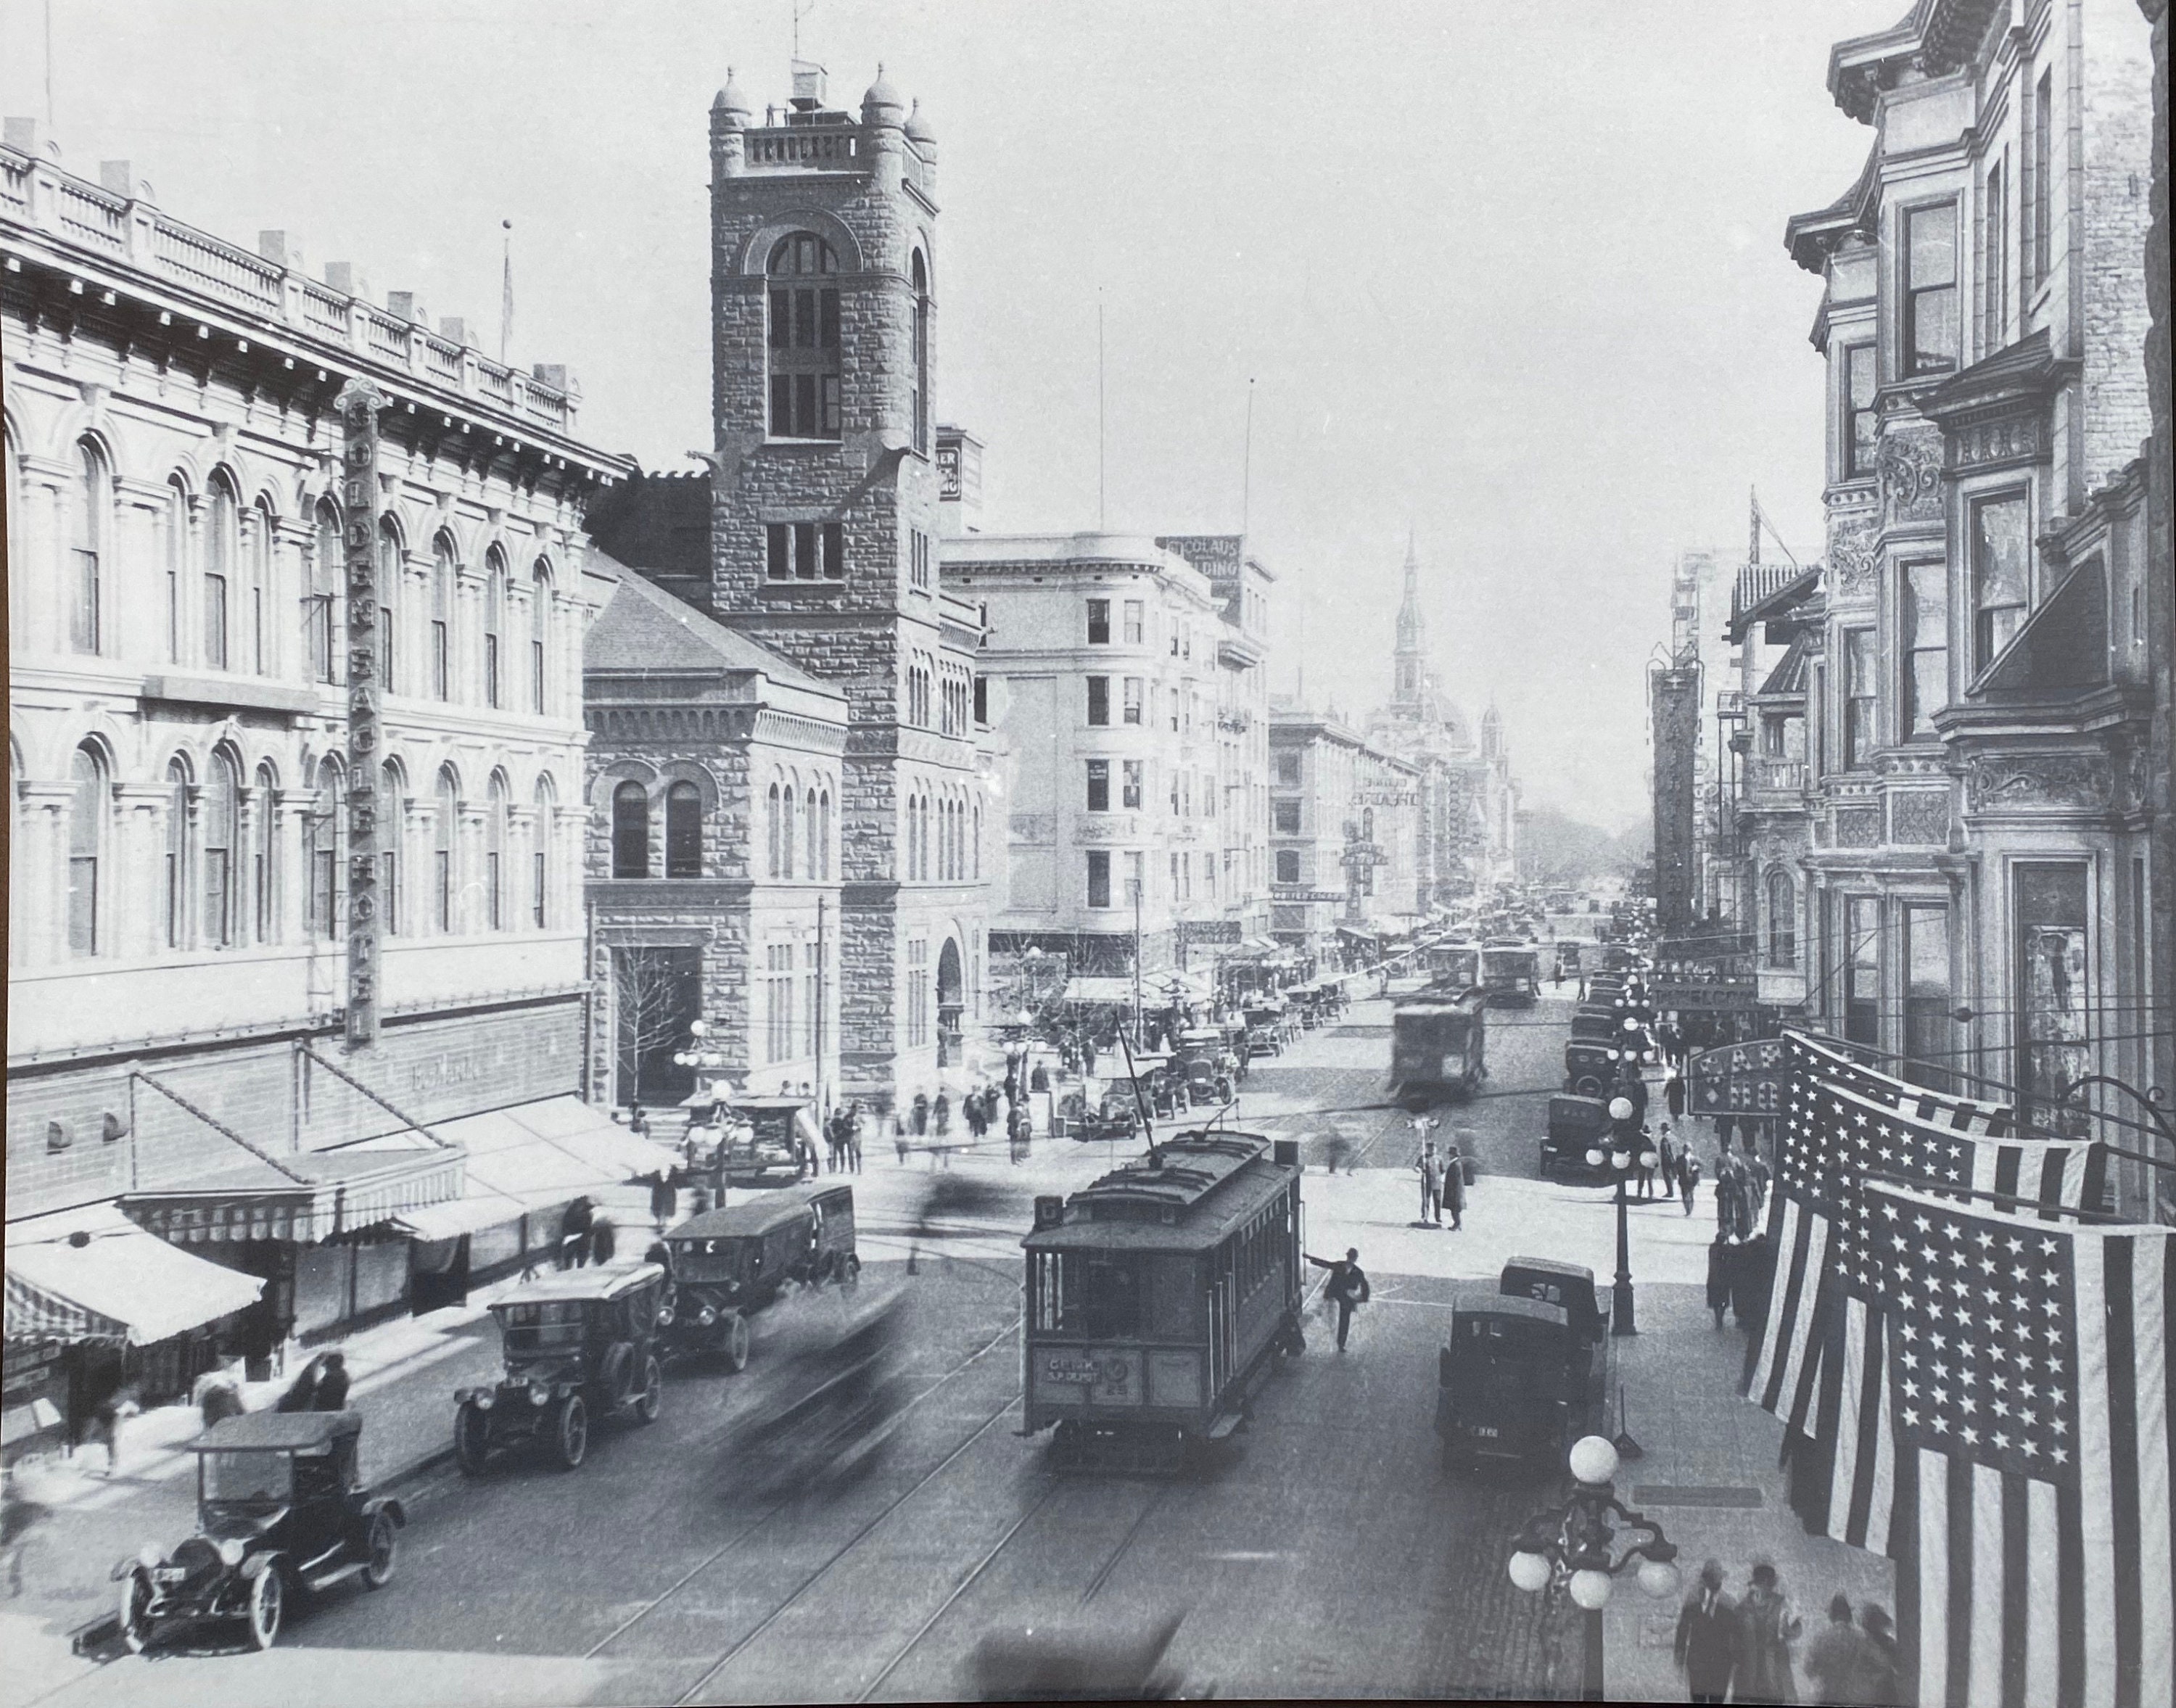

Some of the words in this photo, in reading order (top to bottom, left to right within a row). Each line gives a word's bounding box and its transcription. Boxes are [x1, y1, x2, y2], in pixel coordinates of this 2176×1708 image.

[348, 400, 376, 628] GOLDEN
[350, 648, 376, 833] EAGLE
[350, 854, 376, 1042] HOTEL
